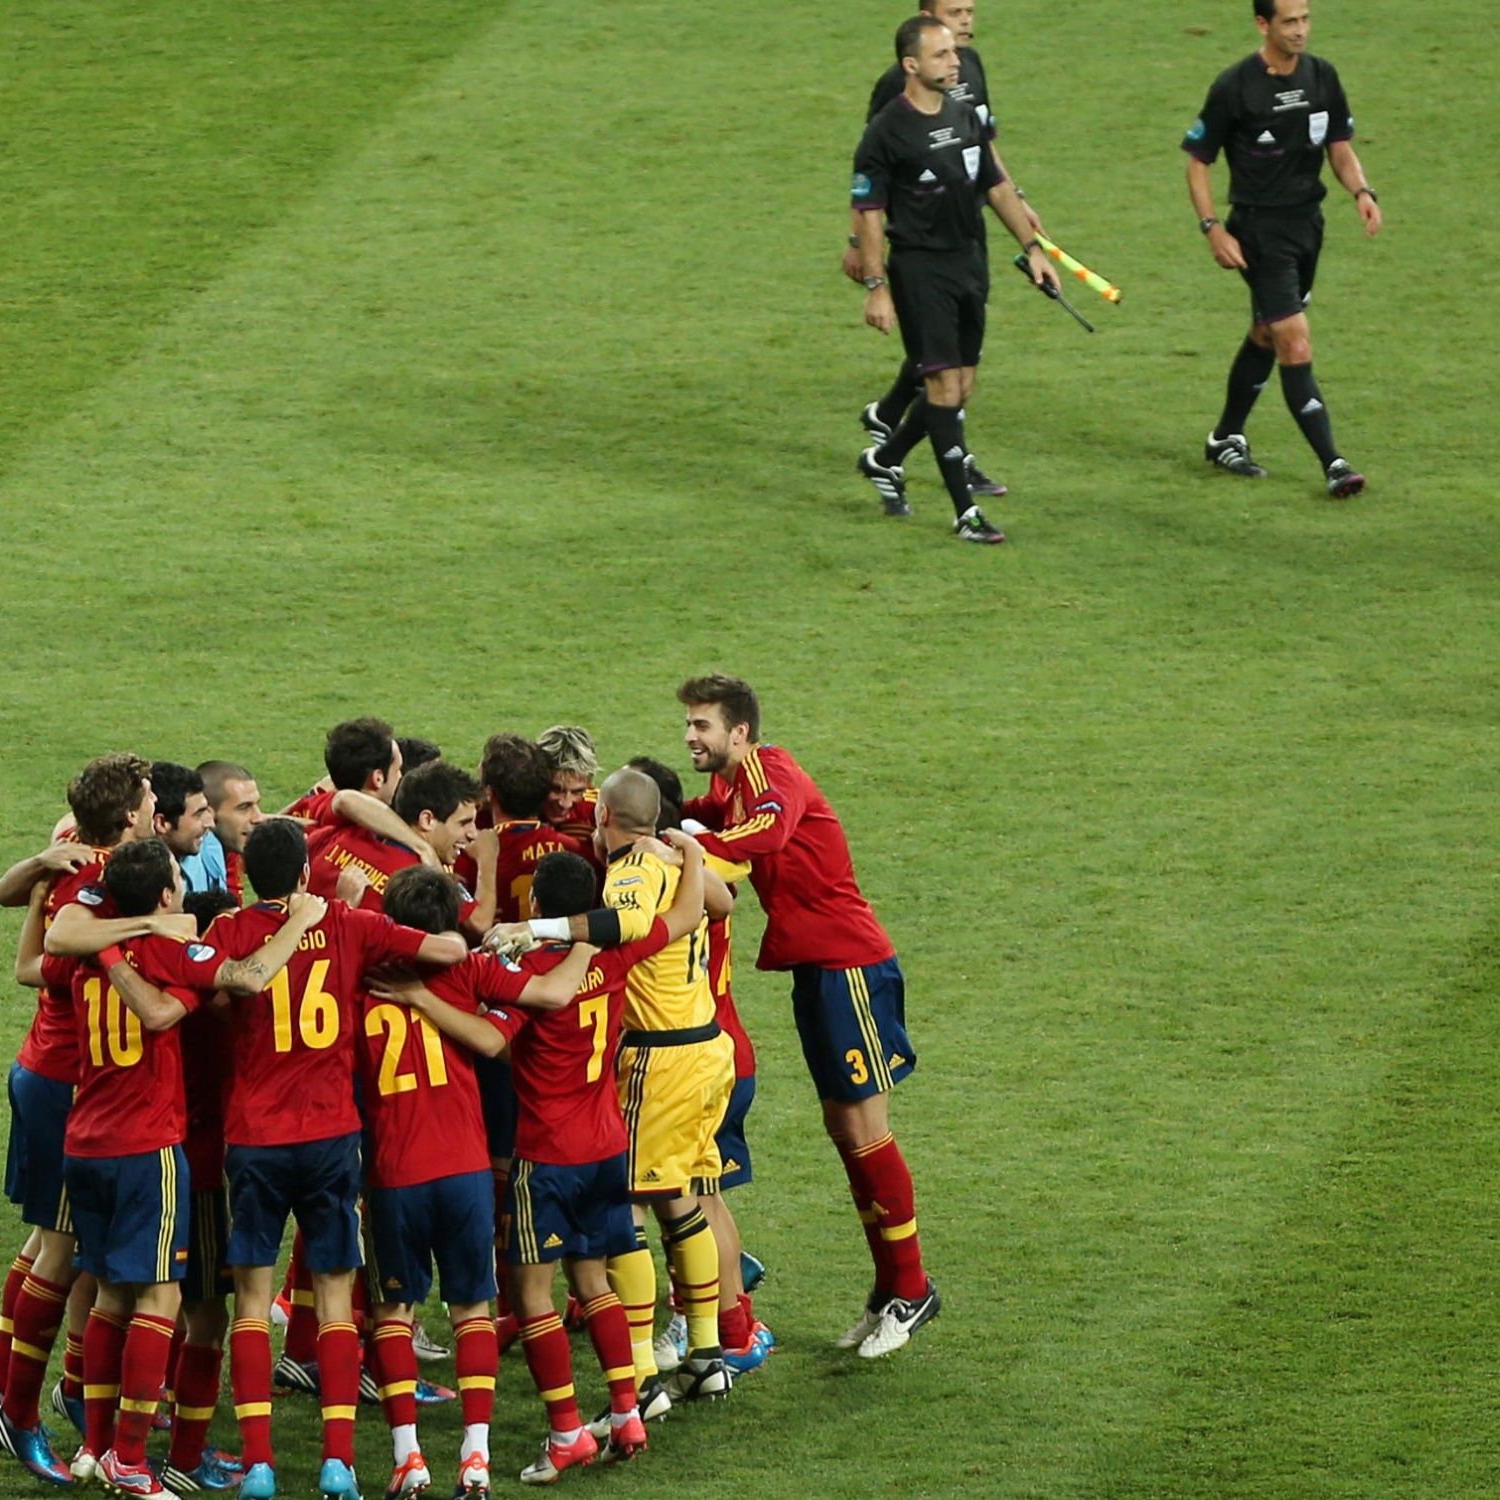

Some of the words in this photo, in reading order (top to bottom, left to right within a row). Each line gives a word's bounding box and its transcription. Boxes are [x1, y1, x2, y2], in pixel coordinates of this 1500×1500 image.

[83, 976, 144, 1067] 10
[263, 958, 340, 1053] 16
[364, 1003, 448, 1096] 21
[578, 992, 610, 1084] 7
[845, 1047, 869, 1085] 3
